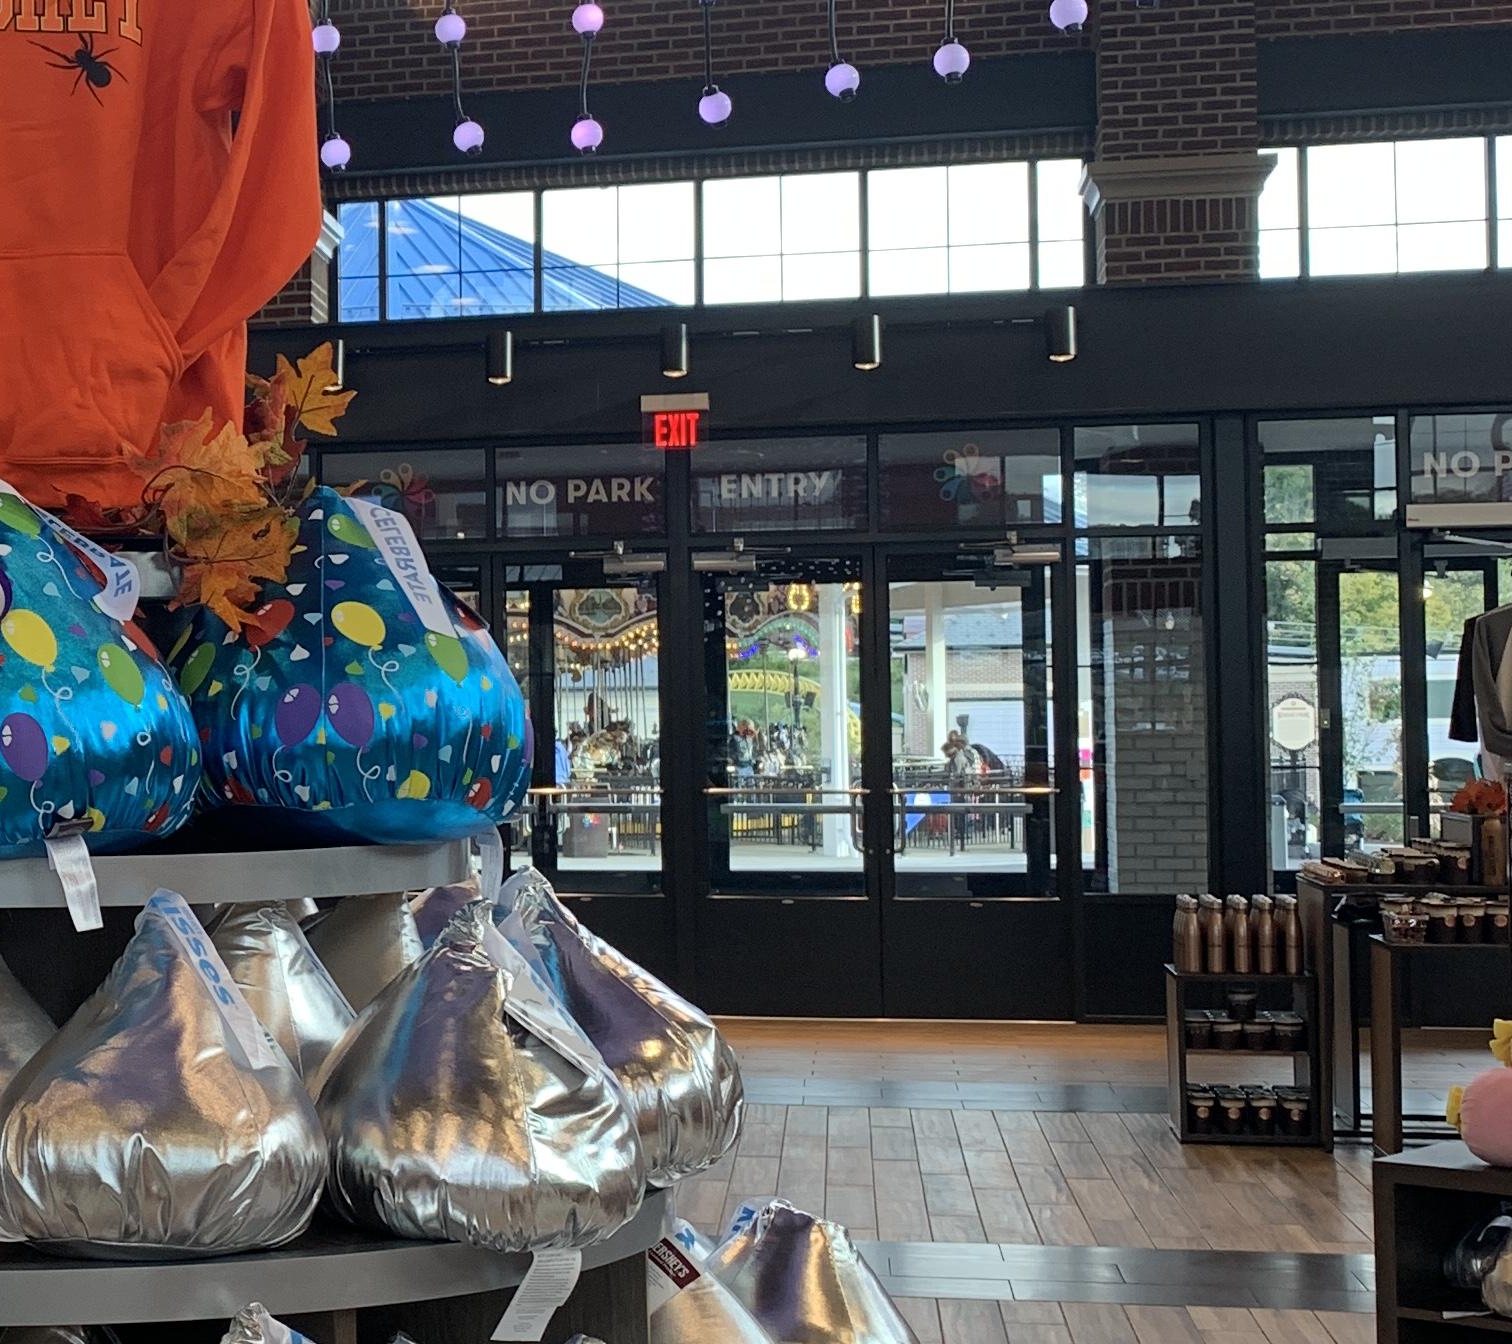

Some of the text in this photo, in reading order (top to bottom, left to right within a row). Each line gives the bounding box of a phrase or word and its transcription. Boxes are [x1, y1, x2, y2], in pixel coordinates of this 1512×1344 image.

[654, 412, 699, 447] EXIT
[1424, 450, 1480, 478] NO
[506, 470, 832, 506] NO PARK ENTRY
